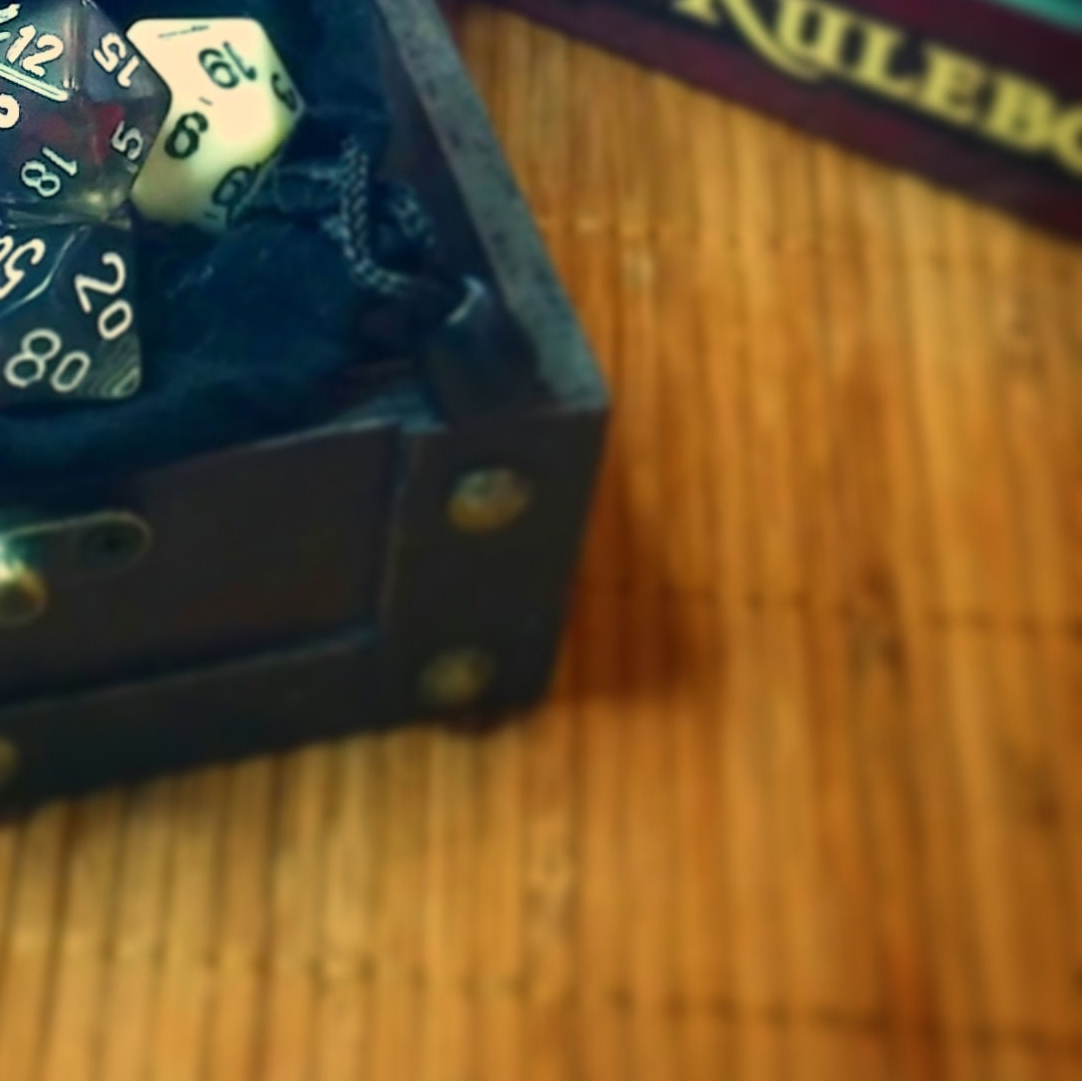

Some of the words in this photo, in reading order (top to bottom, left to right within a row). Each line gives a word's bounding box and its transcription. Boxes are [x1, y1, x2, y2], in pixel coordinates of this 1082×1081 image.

[92, 31, 141, 88] 15
[20, 145, 79, 198] 18
[74, 252, 133, 340] 20
[3, 328, 92, 393] 80
